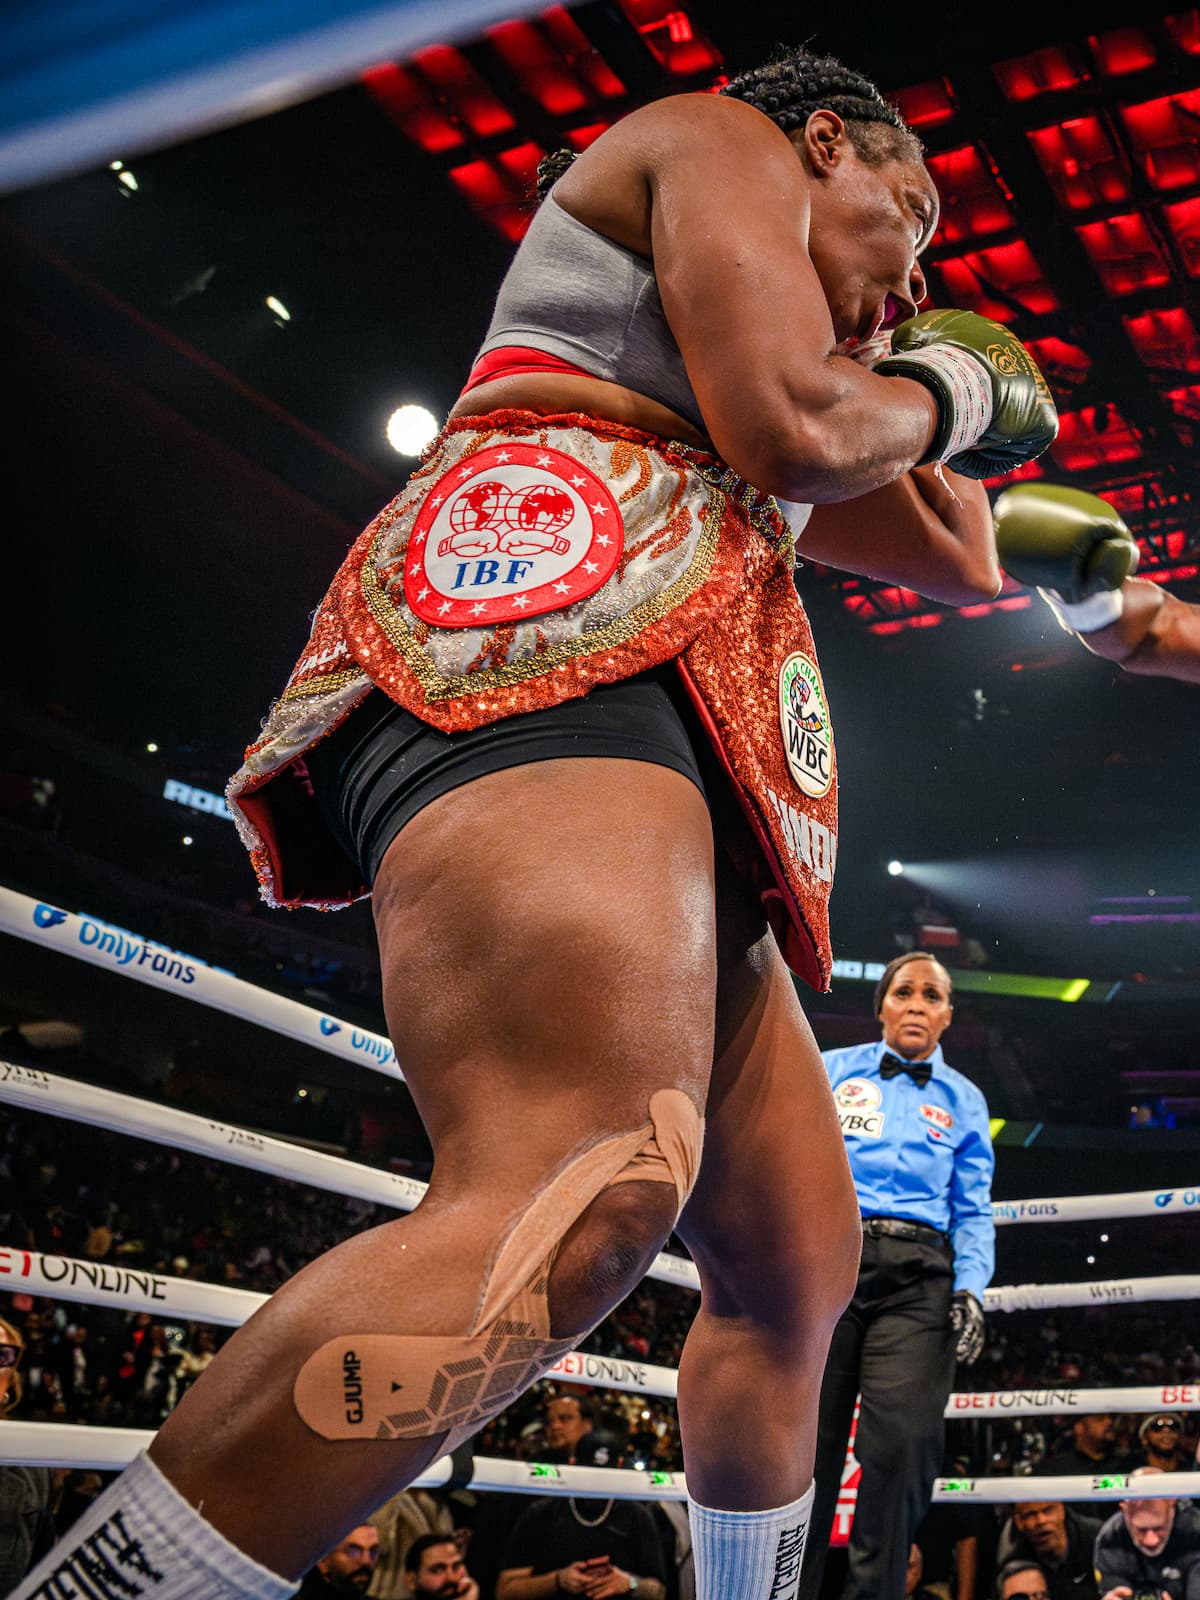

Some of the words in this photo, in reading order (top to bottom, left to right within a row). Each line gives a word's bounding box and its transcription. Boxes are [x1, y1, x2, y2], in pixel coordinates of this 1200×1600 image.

[450, 559, 534, 590] IBF
[783, 662, 799, 706] WORLD
[787, 719, 830, 780] WBC
[78, 920, 197, 984] OnlyFans
[351, 1030, 398, 1065] Only
[343, 1349, 364, 1425] GJUMP
[953, 1390, 1079, 1410] BETONLINE
